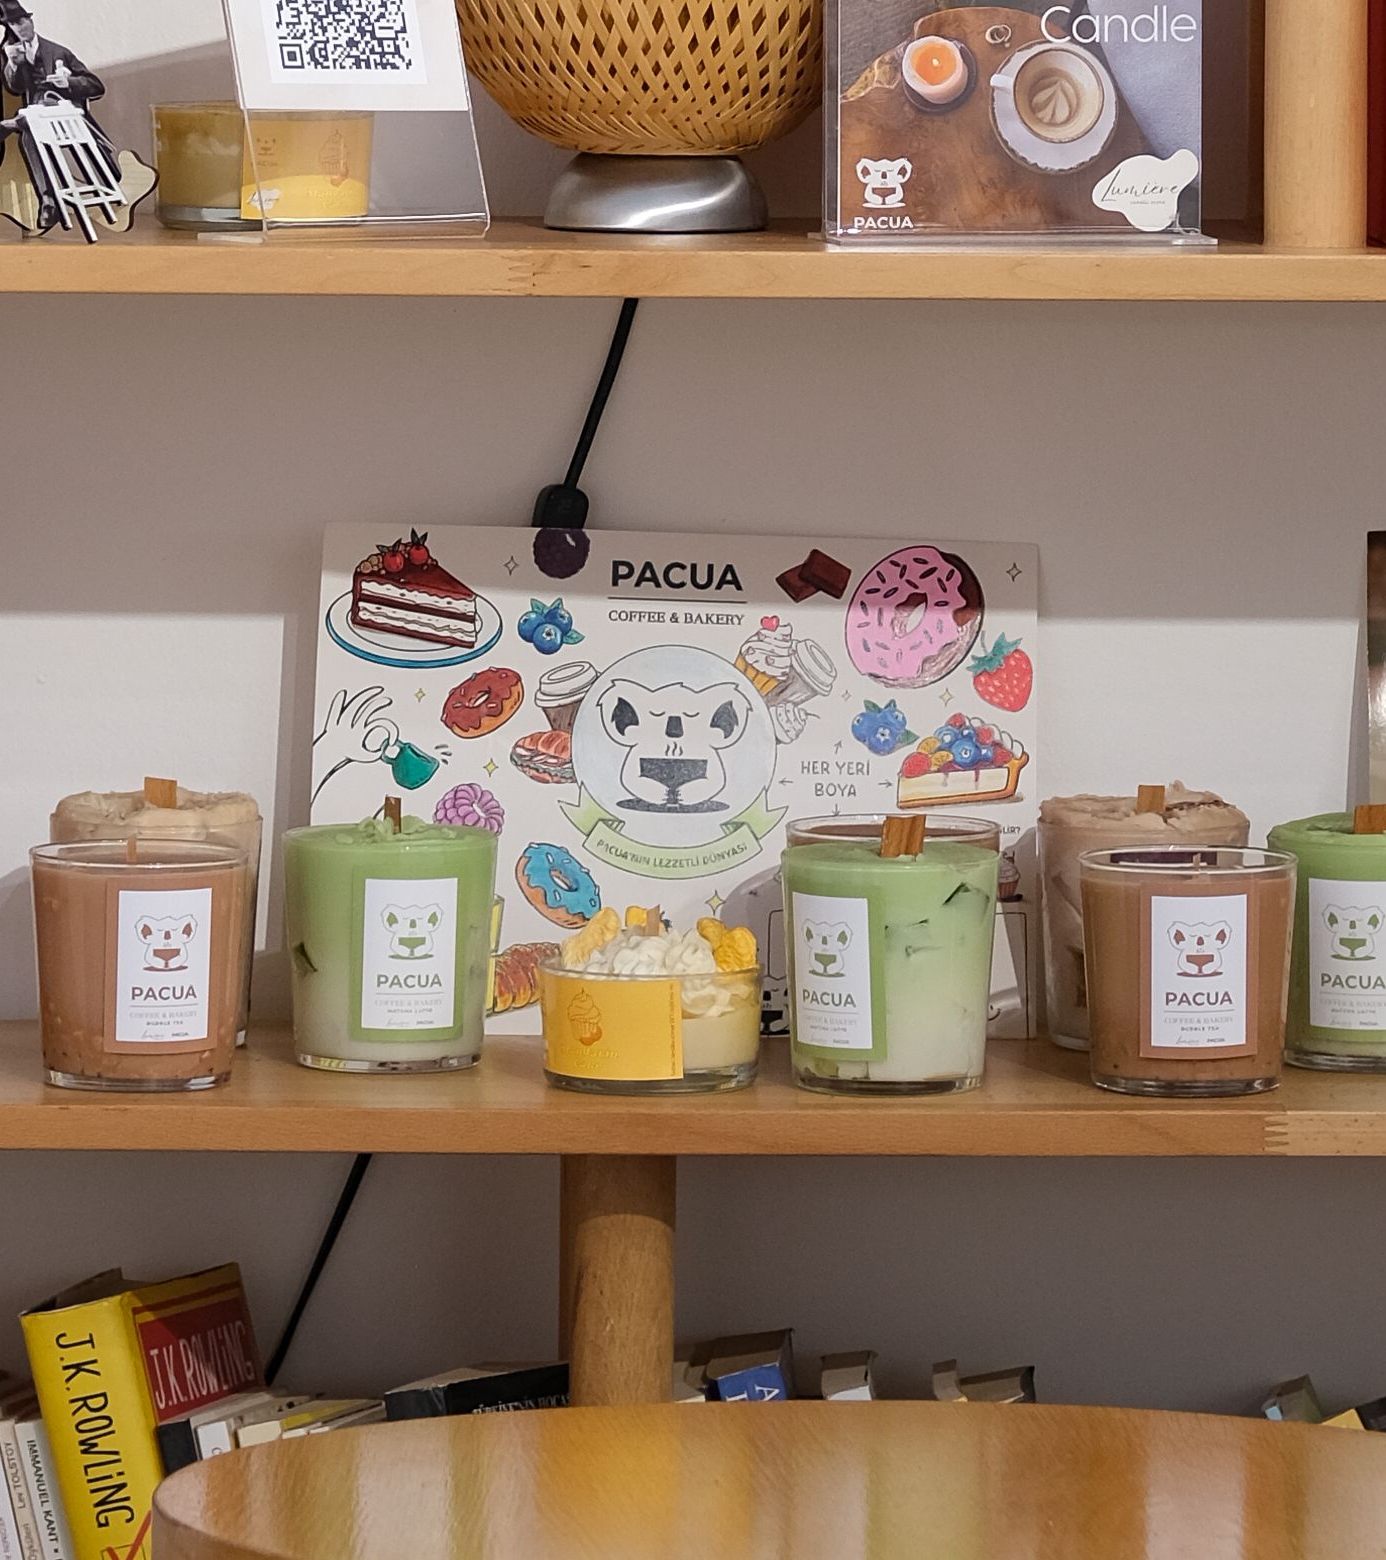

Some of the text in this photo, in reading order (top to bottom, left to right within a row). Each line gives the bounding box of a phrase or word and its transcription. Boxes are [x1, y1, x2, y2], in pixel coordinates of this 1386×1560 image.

[1040, 4, 1198, 44] Candle
[854, 216, 914, 230] PACUA
[612, 560, 743, 591] PACUA
[608, 608, 745, 627] COFFEE & BAKERY
[800, 759, 871, 777] HER YERİ
[814, 782, 858, 799] BOYA
[376, 973, 443, 989] PACUA
[1320, 973, 1386, 990] PACUA
[130, 984, 198, 1001] PACUA
[802, 988, 857, 1008] PACUA
[1165, 991, 1234, 1007] PACUA
